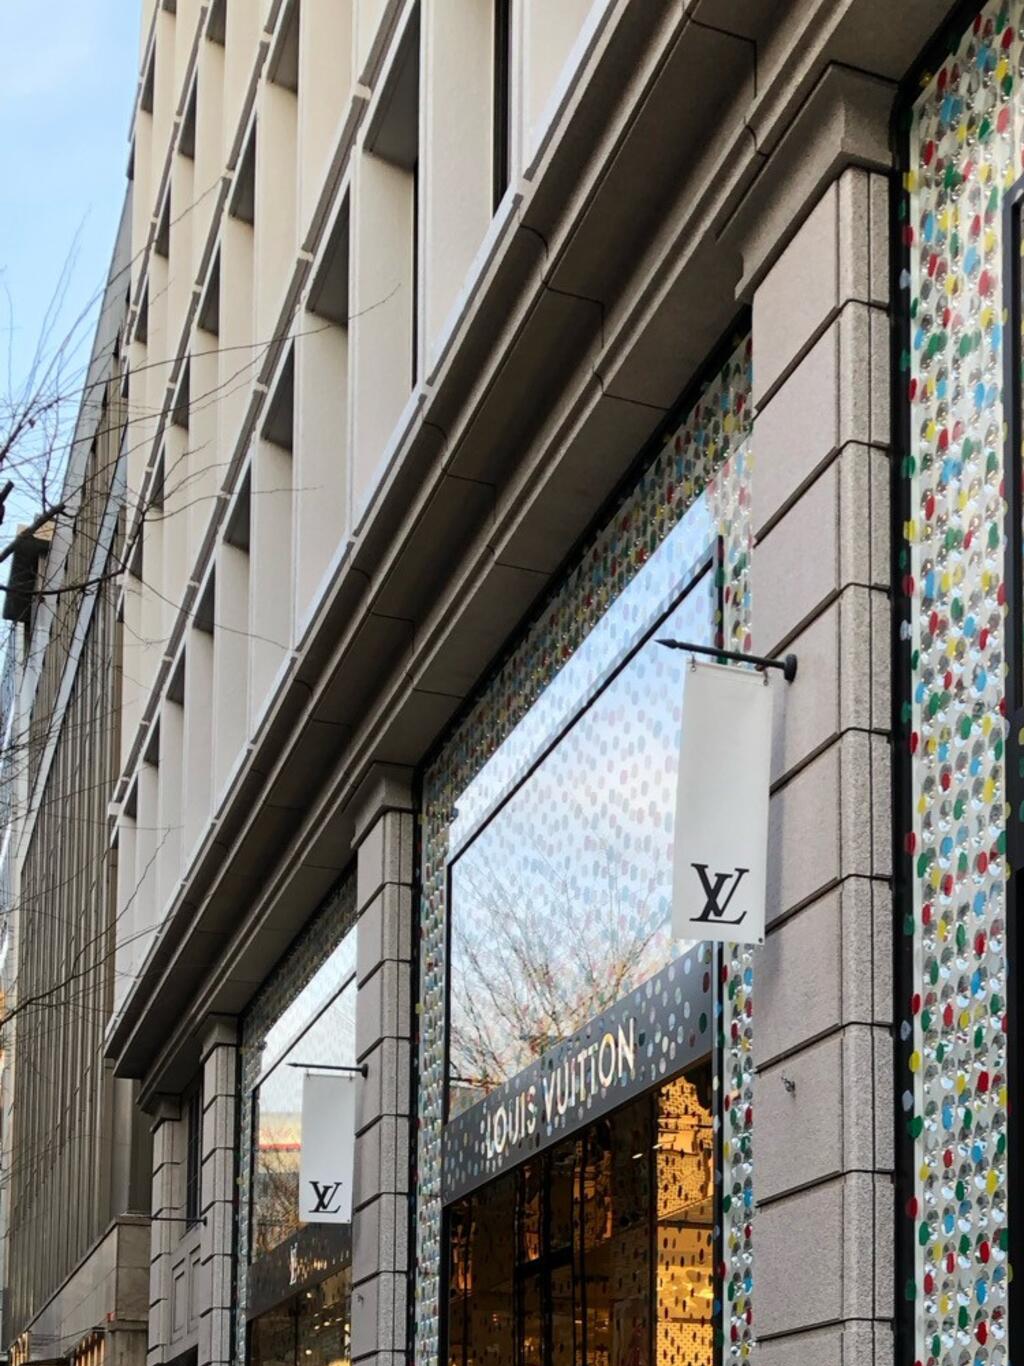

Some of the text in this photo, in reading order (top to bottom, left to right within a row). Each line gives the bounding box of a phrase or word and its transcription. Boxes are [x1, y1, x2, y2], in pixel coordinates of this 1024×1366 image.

[689, 863, 750, 925] LV
[485, 1017, 635, 1159] LOUIS VUITTON
[308, 1181, 343, 1213] LV
